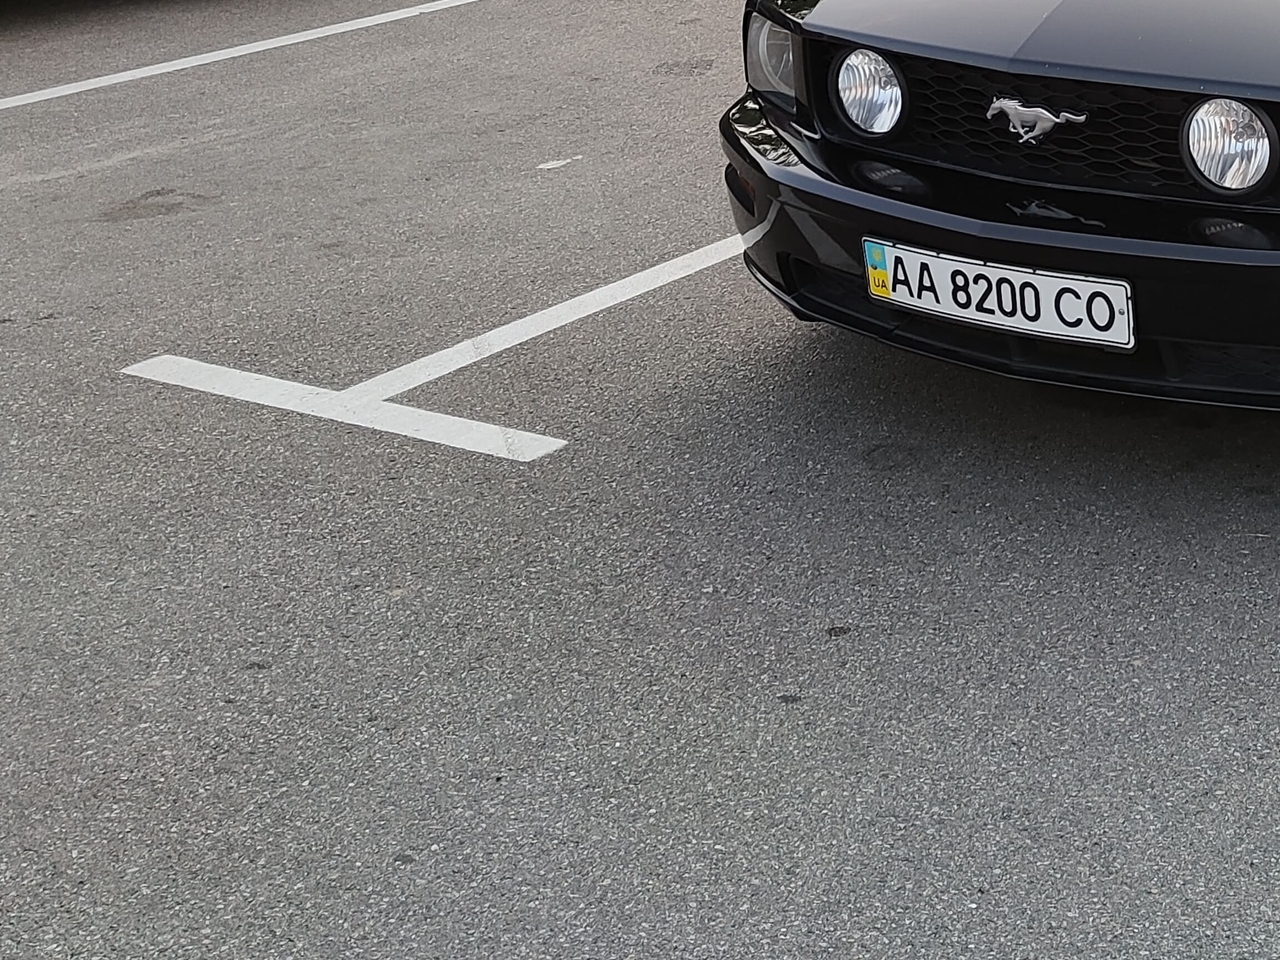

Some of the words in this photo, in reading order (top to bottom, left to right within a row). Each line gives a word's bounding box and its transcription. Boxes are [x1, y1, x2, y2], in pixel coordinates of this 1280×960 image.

[873, 276, 889, 291] UA
[890, 254, 941, 305] AA
[950, 268, 1042, 323] 8200
[1053, 286, 1116, 333] CO
